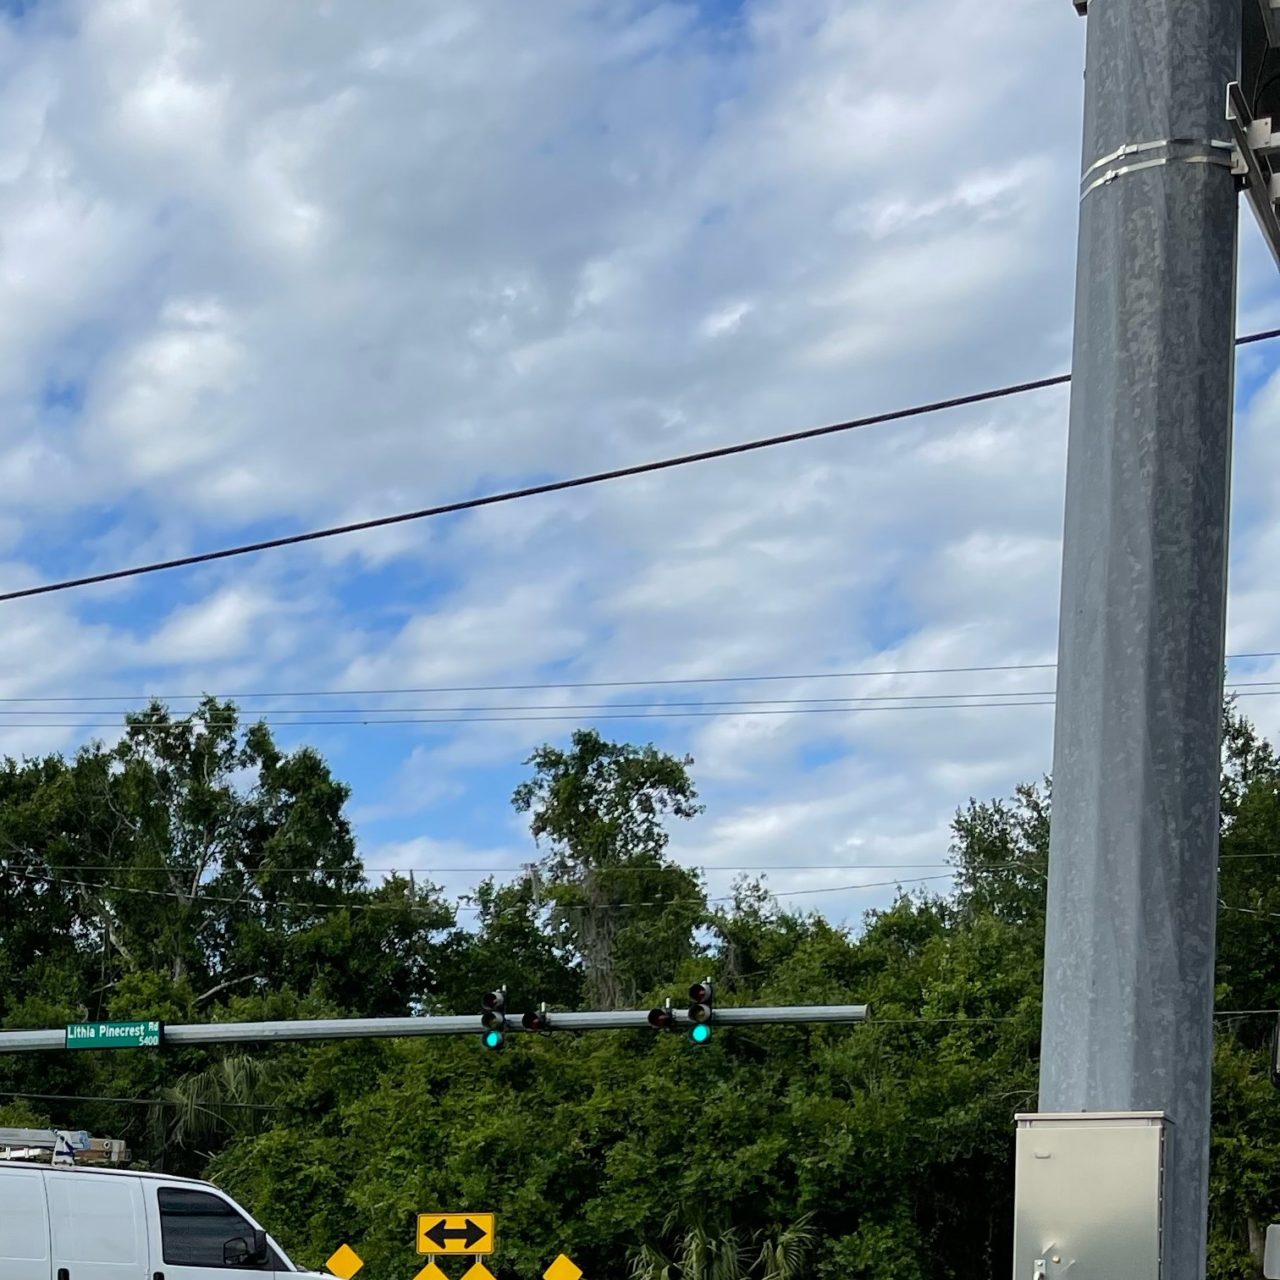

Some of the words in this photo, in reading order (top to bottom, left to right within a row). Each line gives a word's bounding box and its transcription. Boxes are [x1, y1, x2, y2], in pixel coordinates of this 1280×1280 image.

[67, 1025, 95, 1039] Lithia
[99, 1023, 145, 1038] Pinecrest
[148, 1021, 159, 1032] Rd
[138, 1035, 159, 1046] 5400
